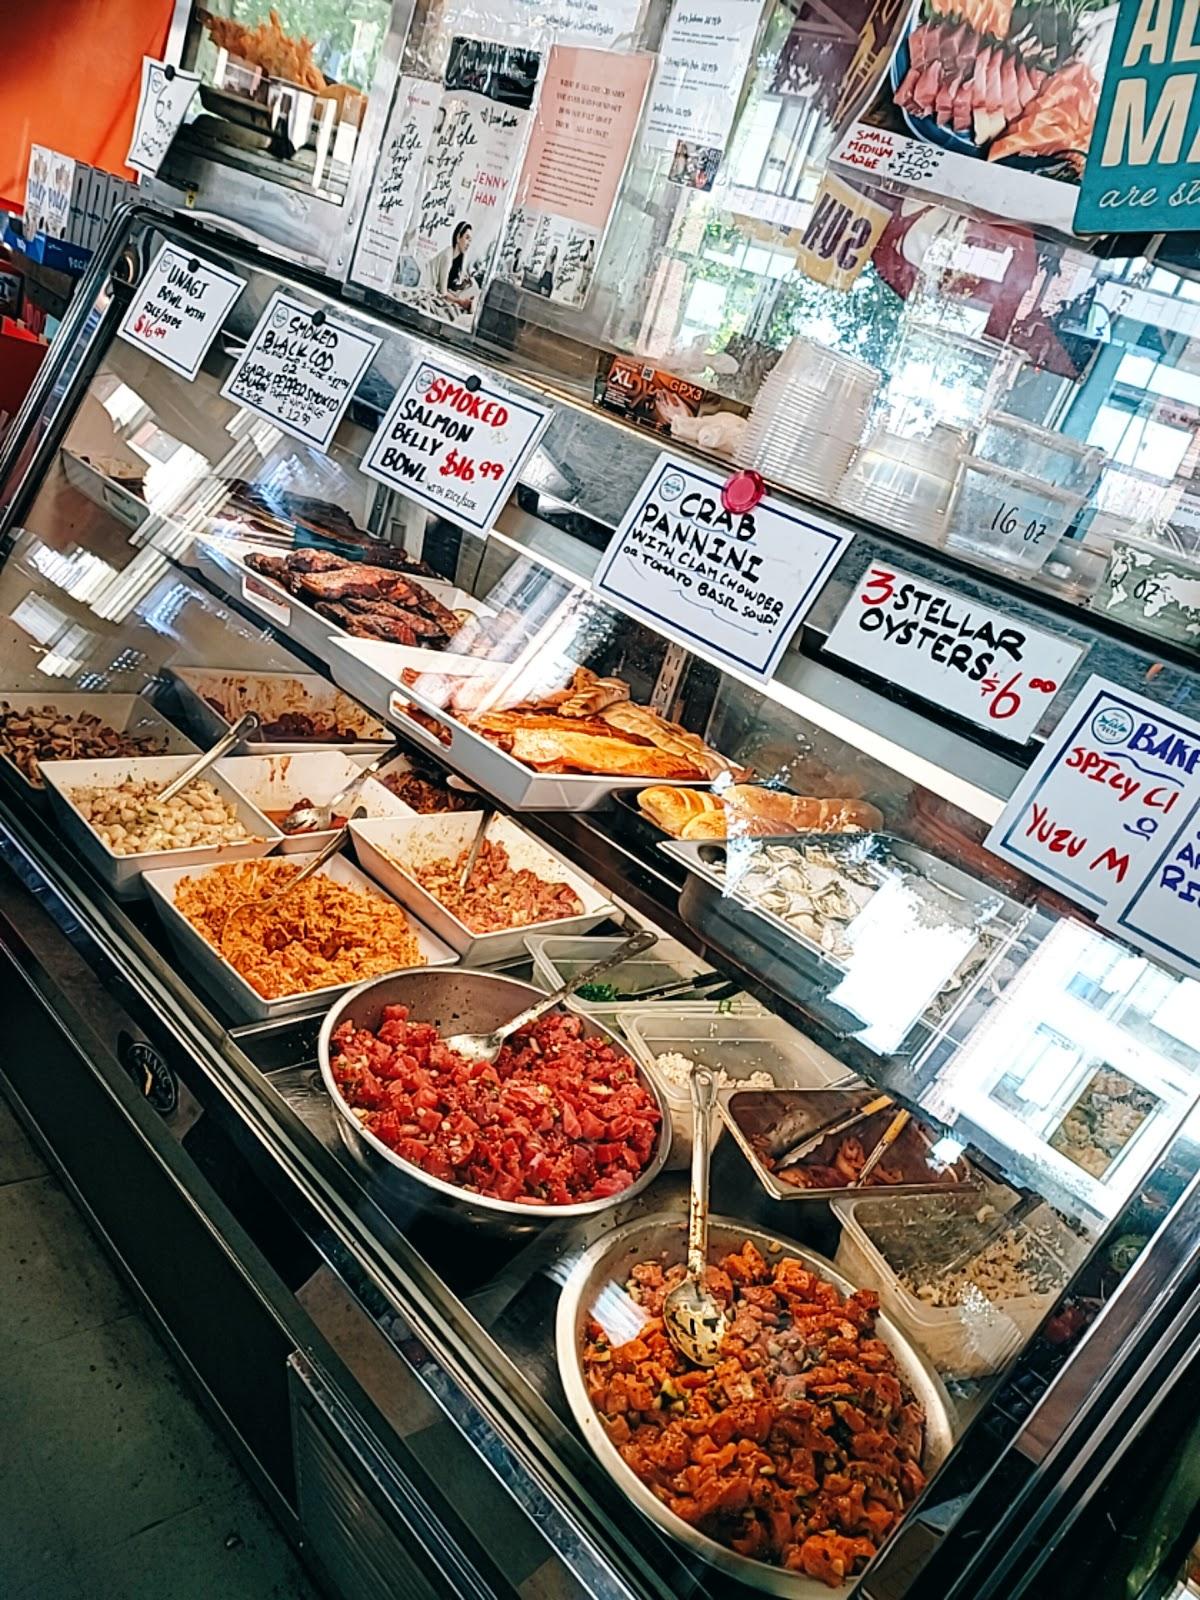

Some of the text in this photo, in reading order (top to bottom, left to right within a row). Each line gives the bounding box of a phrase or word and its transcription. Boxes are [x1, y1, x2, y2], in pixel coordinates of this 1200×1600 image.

[457, 123, 478, 148] the
[848, 140, 893, 158] MEDIUM
[857, 129, 894, 146] SMALL
[840, 152, 880, 169] LARGE
[474, 171, 509, 189] JENNY
[421, 188, 452, 210] loved
[474, 192, 497, 207] HAN
[1100, 186, 1159, 208] are
[418, 212, 452, 238] before
[157, 285, 182, 309] BOWL
[167, 264, 210, 299] UNAGI
[263, 330, 309, 358] BLACK
[288, 316, 339, 349] SMOKED
[611, 367, 633, 388] XL
[669, 380, 703, 401] GPX3
[425, 377, 509, 427] SMOKED
[400, 398, 475, 443] SALMON
[391, 422, 444, 456] BELLY
[380, 447, 428, 482] BOWL
[679, 492, 757, 541] CRAB
[991, 502, 1019, 534] 16
[641, 503, 764, 584] PANNINI
[622, 545, 638, 557] OR
[642, 555, 693, 588] TOMATO
[697, 582, 738, 613] BASIL
[632, 529, 785, 618] WITH CLAM CHOWDER
[892, 584, 1027, 662] STELLAR
[859, 607, 995, 681] OYSTERS
[1065, 747, 1141, 802] SPICY
[1025, 803, 1130, 884] YUZU M
[1160, 865, 1200, 908] RI
